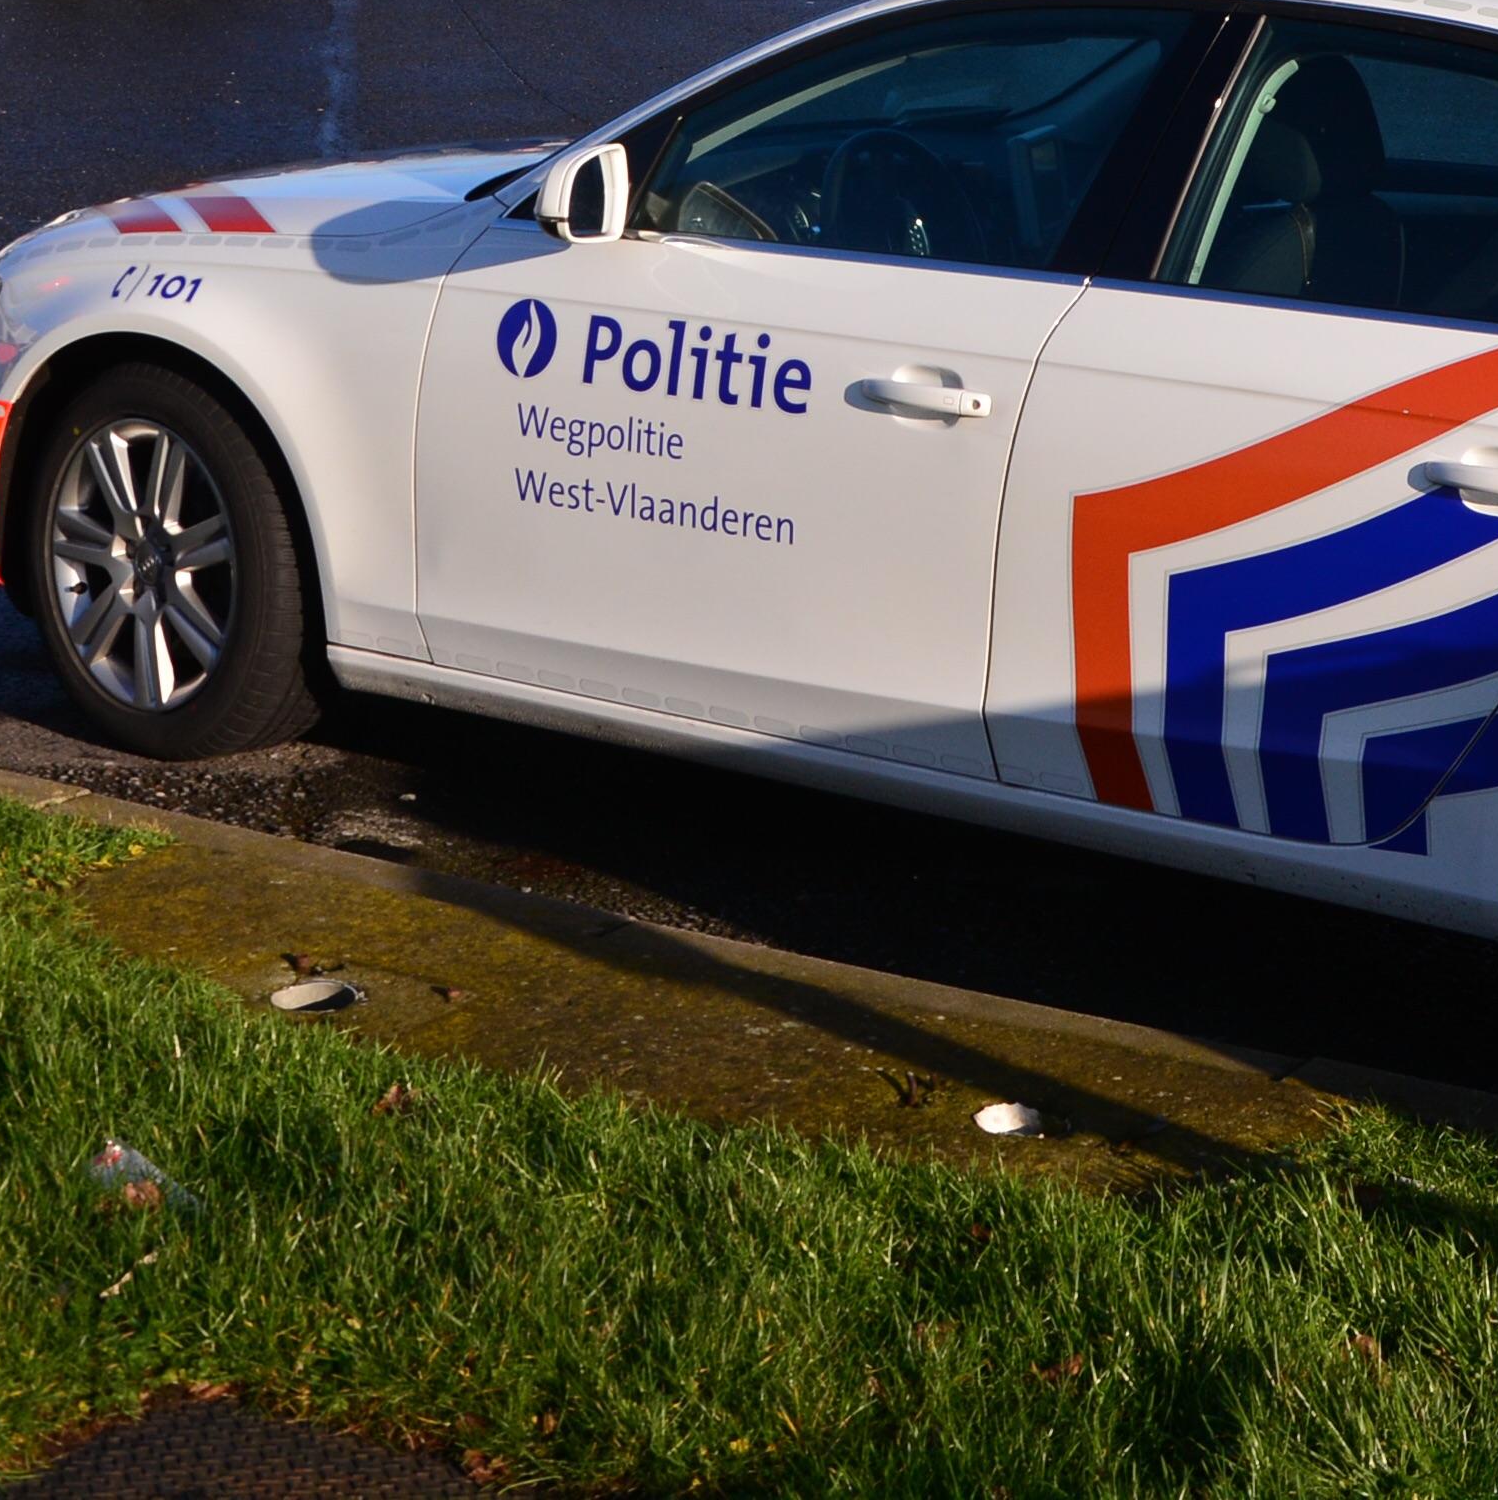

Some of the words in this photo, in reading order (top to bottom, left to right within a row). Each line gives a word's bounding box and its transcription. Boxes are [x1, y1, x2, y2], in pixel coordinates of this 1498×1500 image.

[147, 273, 204, 303] 101
[582, 314, 813, 414] Politie
[517, 402, 684, 460] Wegpolitie
[514, 467, 795, 546] West-Vlaanderen
